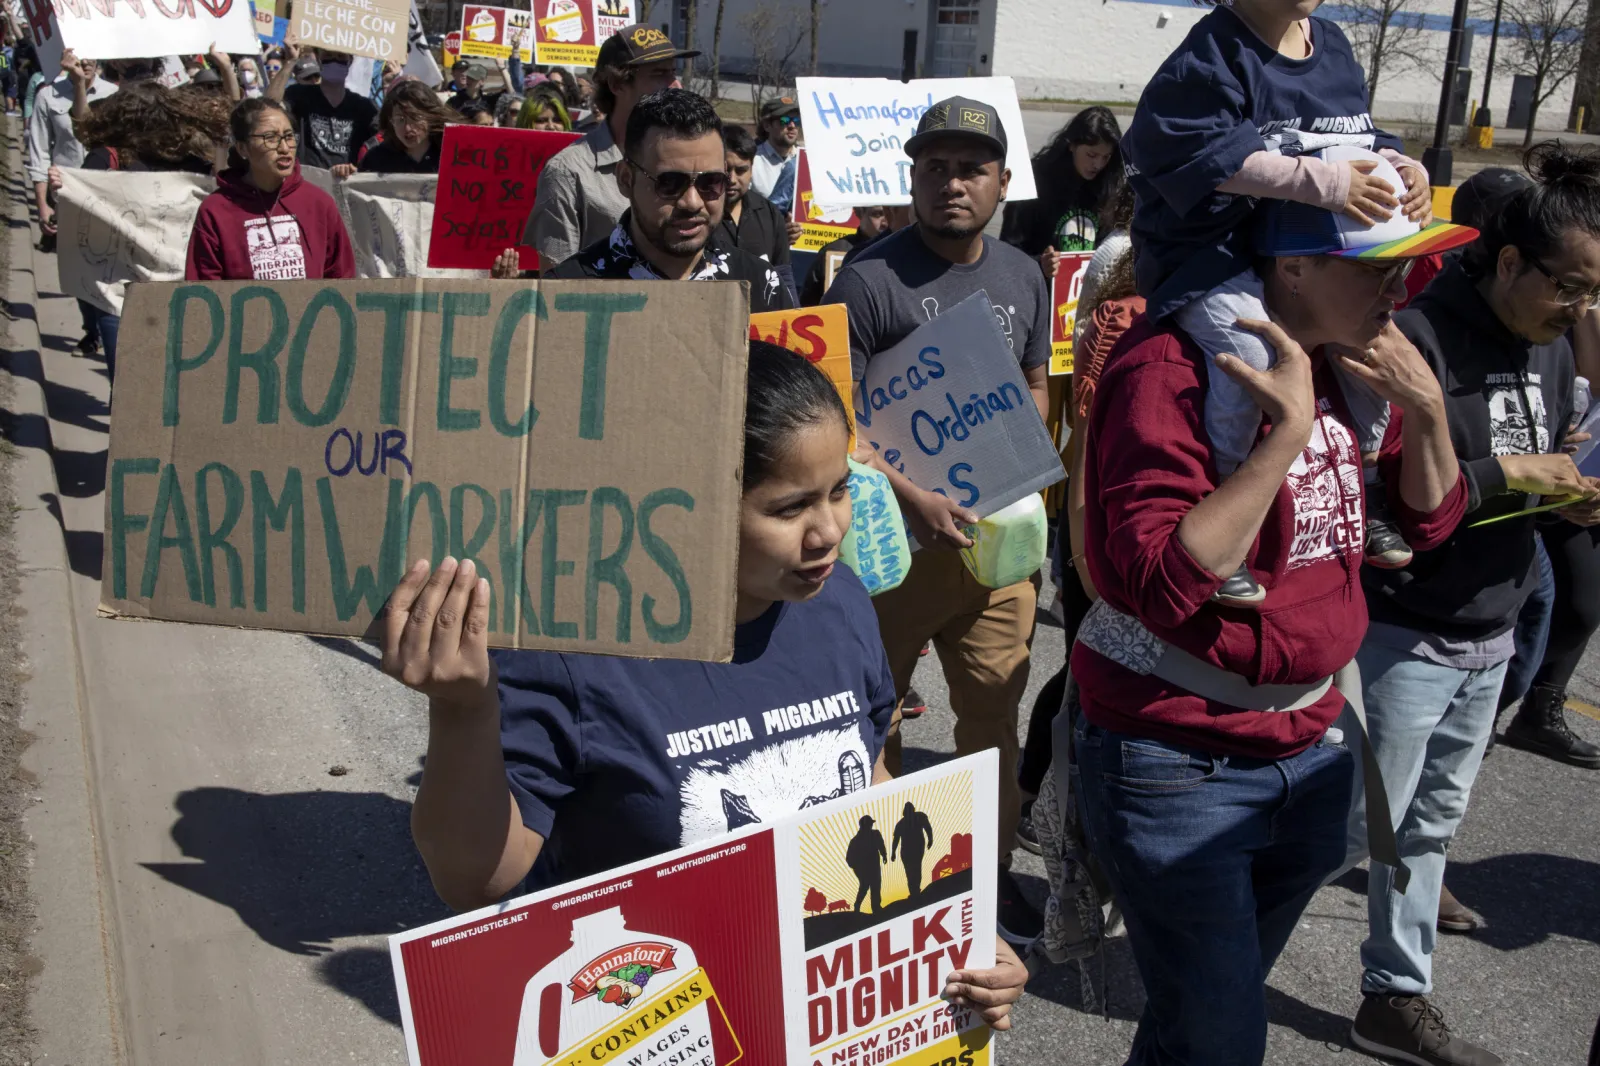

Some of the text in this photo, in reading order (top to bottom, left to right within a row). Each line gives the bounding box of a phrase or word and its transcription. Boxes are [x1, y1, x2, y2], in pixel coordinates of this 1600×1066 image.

[301, 19, 393, 57] DIGNIDAD
[304, 2, 357, 27] LECHE
[360, 14, 396, 35] CON
[598, 18, 625, 27] MILK
[445, 40, 460, 48] STO
[845, 132, 902, 156] Join
[826, 166, 890, 195] With
[253, 259, 303, 272] MIGRANT
[258, 267, 305, 280] JUSTICE
[163, 285, 648, 441] PROTECT
[325, 427, 413, 477] OUR
[666, 690, 861, 759] JUSTICIA MIGRANTE
[431, 843, 747, 949] MIGRANTJUSTICE.NET @MIGRANTJUSTICE MILKWITHDIGNITY.ORG
[806, 897, 973, 996] MILK WITH
[577, 947, 667, 989] Hannaford
[808, 938, 973, 1047] DIGNITY
[590, 981, 703, 1061] CONTAINS
[832, 1034, 881, 1065] NEW
[888, 1015, 927, 1041] DAY
[862, 1036, 911, 1066] RIGHTS
[915, 1029, 928, 1048] IN
[933, 1011, 973, 1040] DAIRY
[628, 1024, 690, 1066] WAGES
